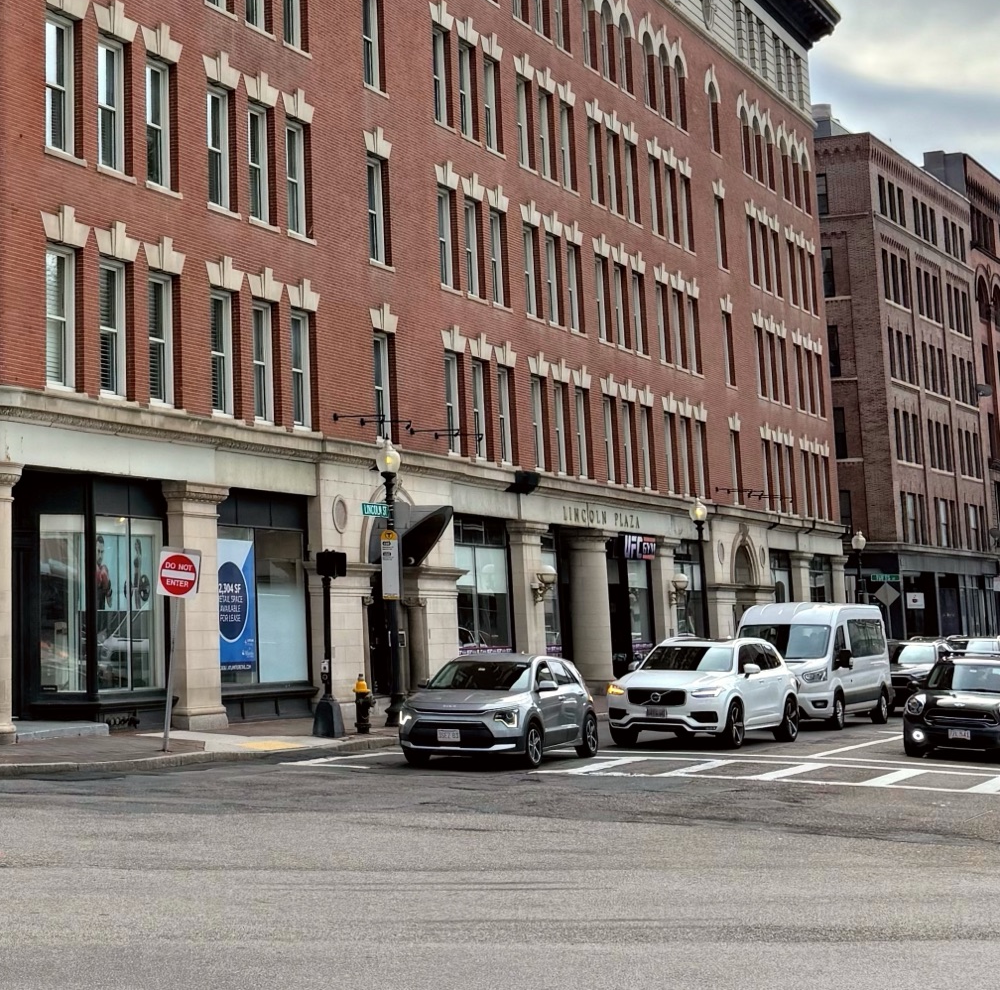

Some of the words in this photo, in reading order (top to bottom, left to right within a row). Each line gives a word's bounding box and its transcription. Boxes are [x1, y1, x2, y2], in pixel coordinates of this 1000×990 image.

[563, 506, 607, 525] LINCOLN
[614, 512, 640, 529] PLAZA
[624, 535, 643, 559] UFC
[166, 578, 189, 587] ENTER
[234, 583, 241, 594] SF
[219, 595, 230, 603] ETAIL
[231, 595, 243, 603] SPACE
[229, 614, 241, 623] LEASE
